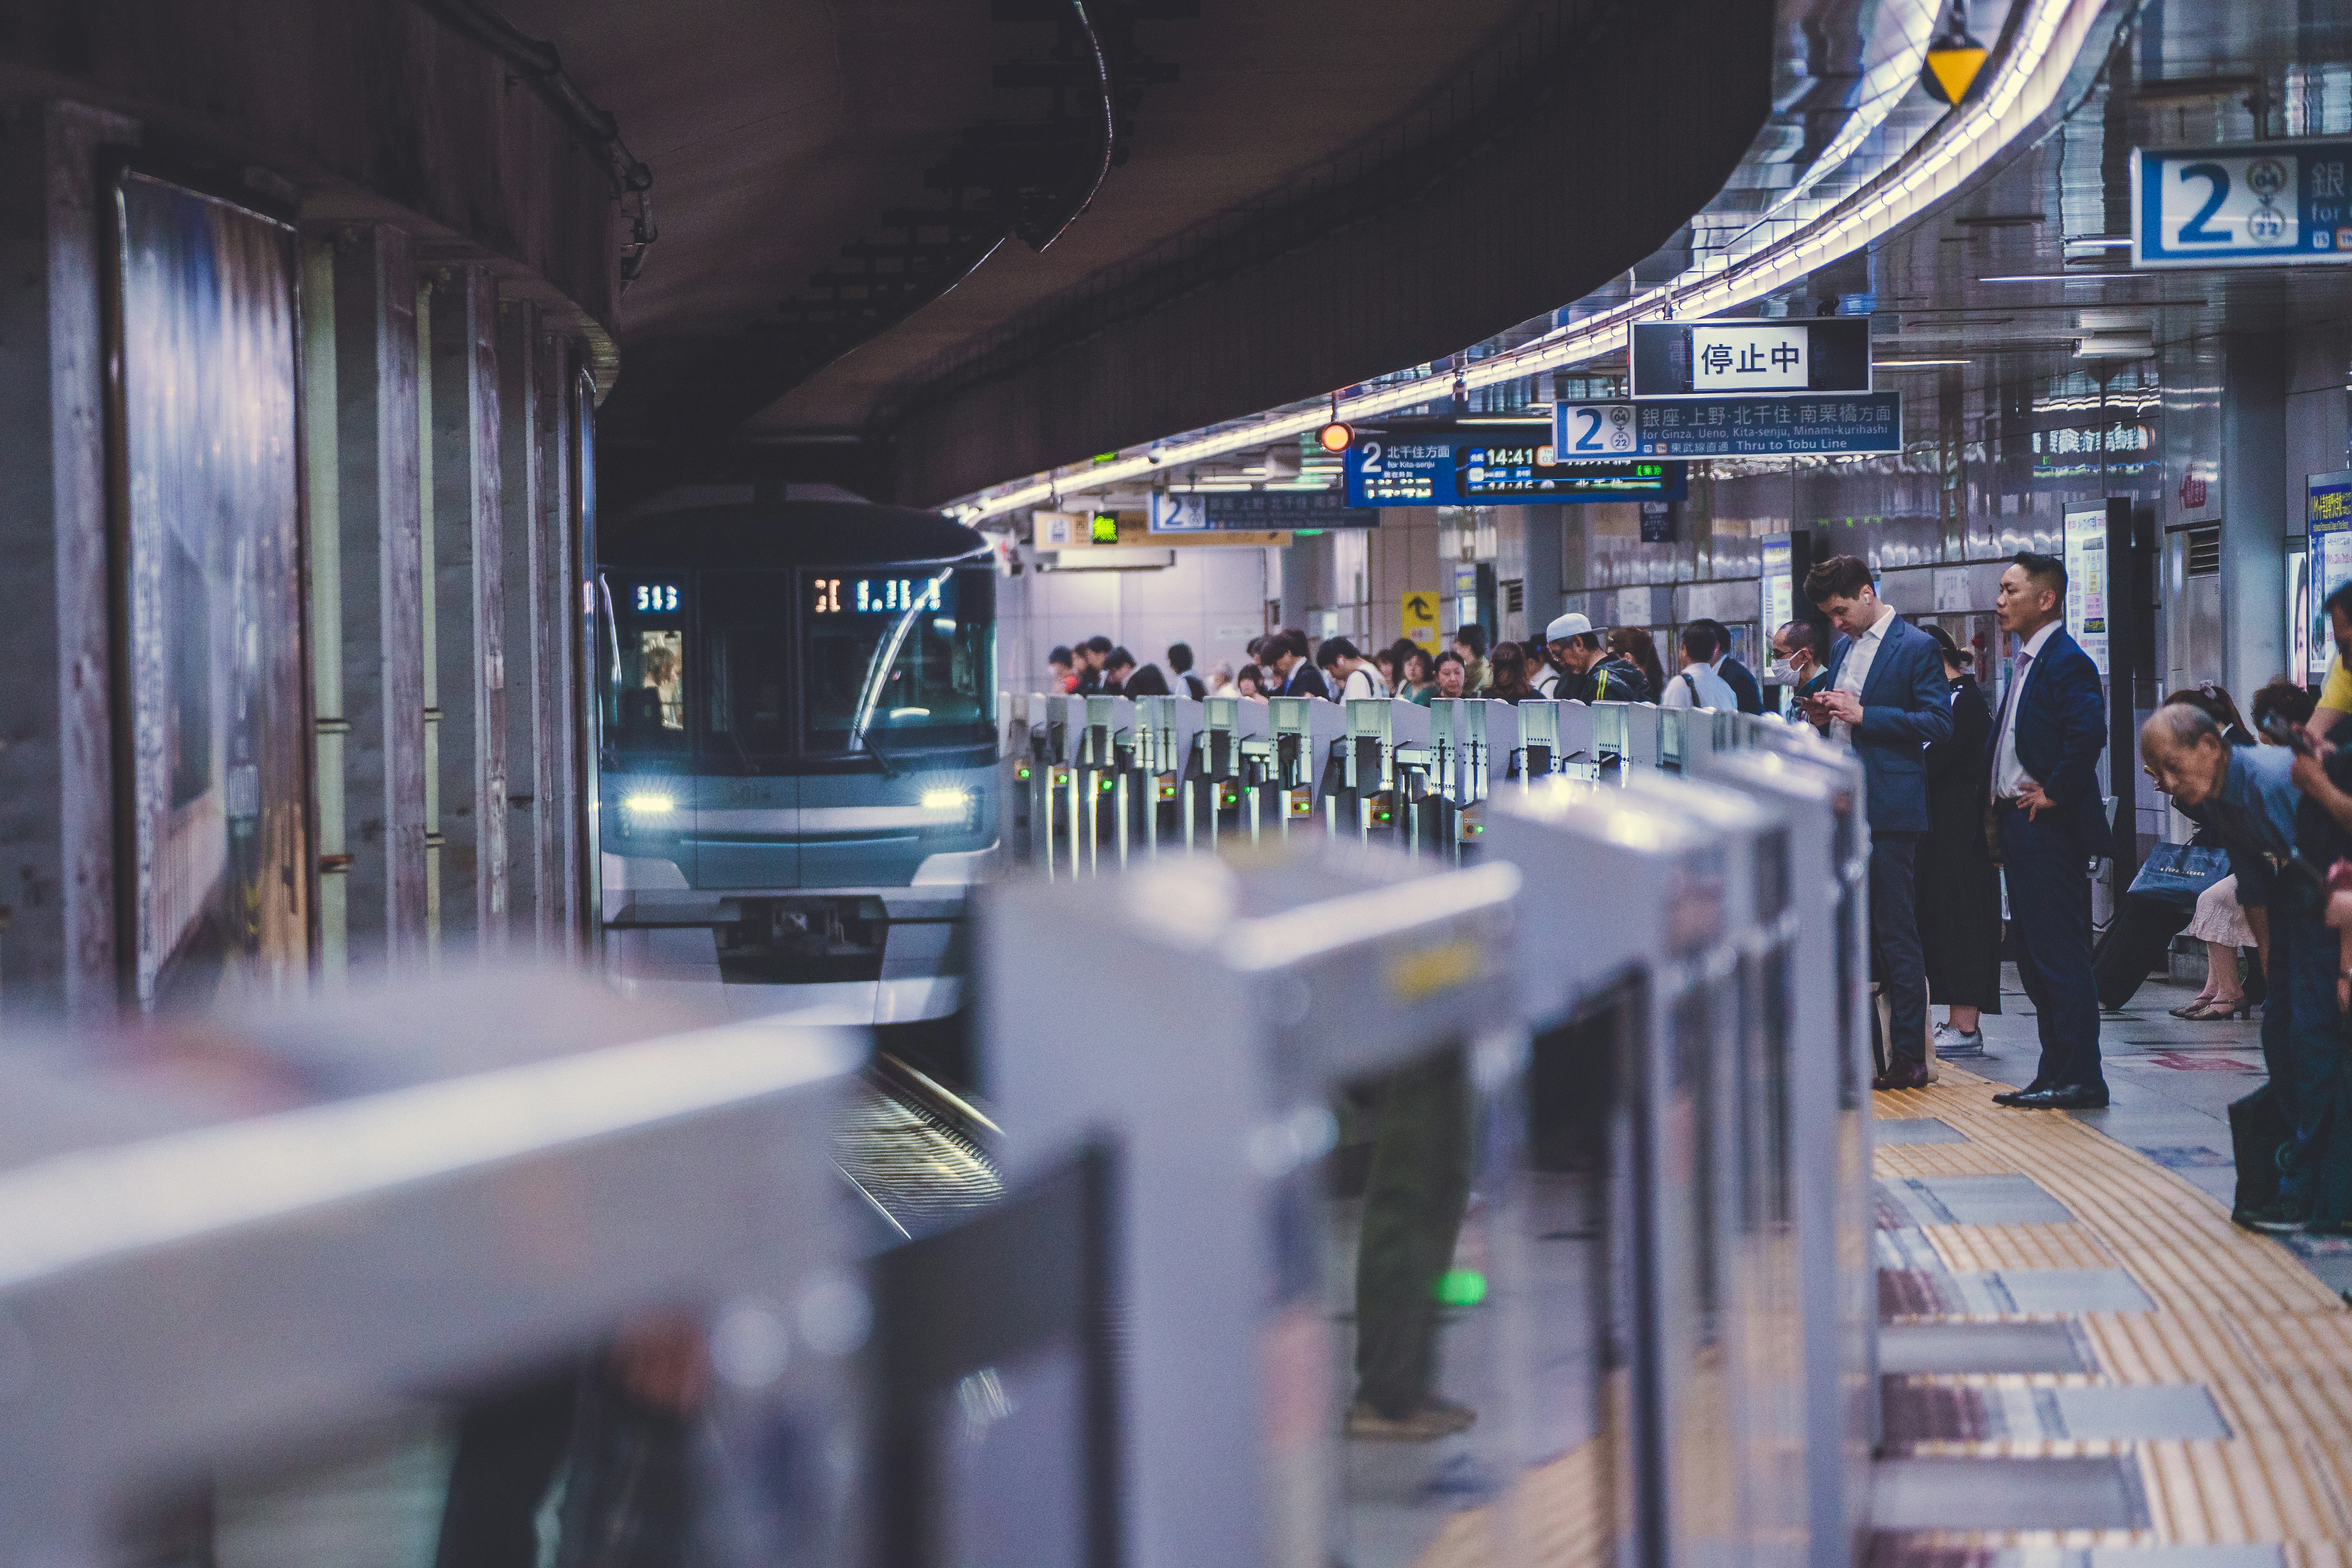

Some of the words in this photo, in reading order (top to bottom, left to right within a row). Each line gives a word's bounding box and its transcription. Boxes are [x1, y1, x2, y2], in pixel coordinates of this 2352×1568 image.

[2179, 163, 2232, 244] 2
[1701, 342, 1799, 375] 停止中
[1576, 408, 1604, 450] 2
[1643, 429, 1658, 439] for
[1662, 429, 1695, 439] Ginza,
[1699, 428, 1729, 438] Ueno,
[1733, 427, 1790, 438] Kita-senju,
[1794, 424, 1888, 436] Minami-kurihashi
[1361, 441, 1382, 473] 2
[1387, 445, 1450, 459] 北千住方面
[1486, 448, 1533, 465] 14:41
[1737, 440, 1765, 451] Thru
[1770, 441, 1783, 450] to
[1787, 439, 1816, 450] Tobu
[1821, 438, 1847, 448] Line
[1165, 497, 1183, 525] 2
